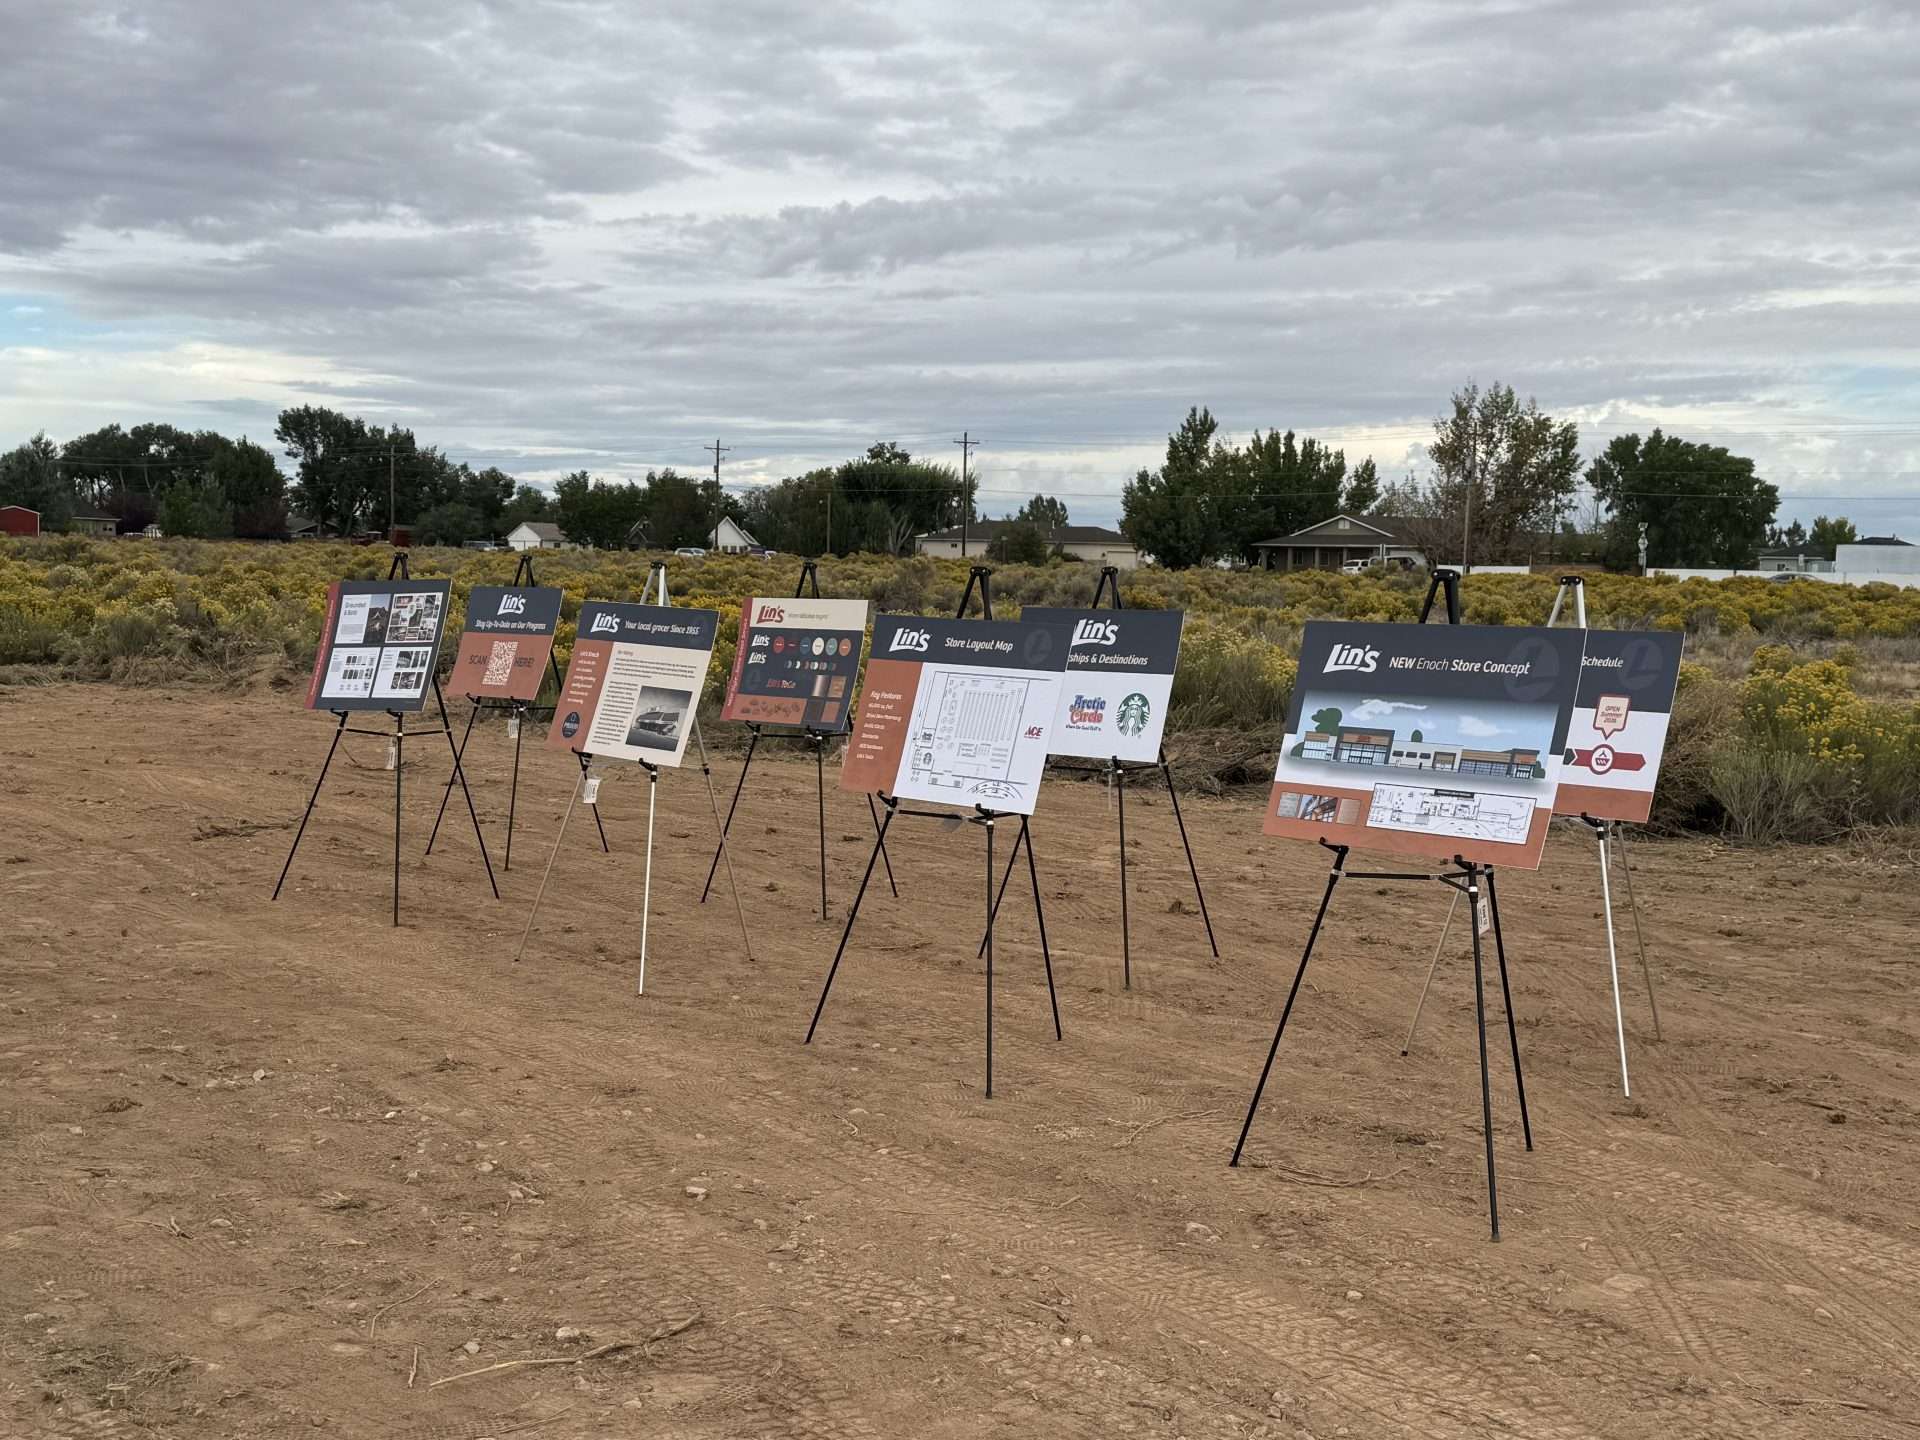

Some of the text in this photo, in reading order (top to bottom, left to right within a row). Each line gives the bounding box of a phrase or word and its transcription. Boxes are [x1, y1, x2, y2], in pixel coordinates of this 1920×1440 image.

[497, 593, 527, 616] Lin's
[756, 604, 785, 624] Lin's
[590, 612, 621, 634] Lin's
[624, 620, 636, 630] Your
[637, 621, 652, 631] local
[651, 624, 670, 634] grocer
[670, 624, 685, 634] Since
[752, 634, 770, 647] Lin's
[888, 627, 932, 652] Lin's
[1072, 618, 1120, 646] Lin's
[944, 637, 1014, 654] Store Layout Map
[468, 654, 488, 664] SCAN
[748, 652, 767, 664] Lin's
[1068, 654, 1149, 666] ships & Destinations
[1322, 644, 1382, 674] Lin's
[1582, 656, 1624, 668] Schedule
[1389, 656, 1530, 678] NEW Enoch Store Concept
[1074, 694, 1106, 711] Arctic
[1024, 726, 1044, 737] ACE
